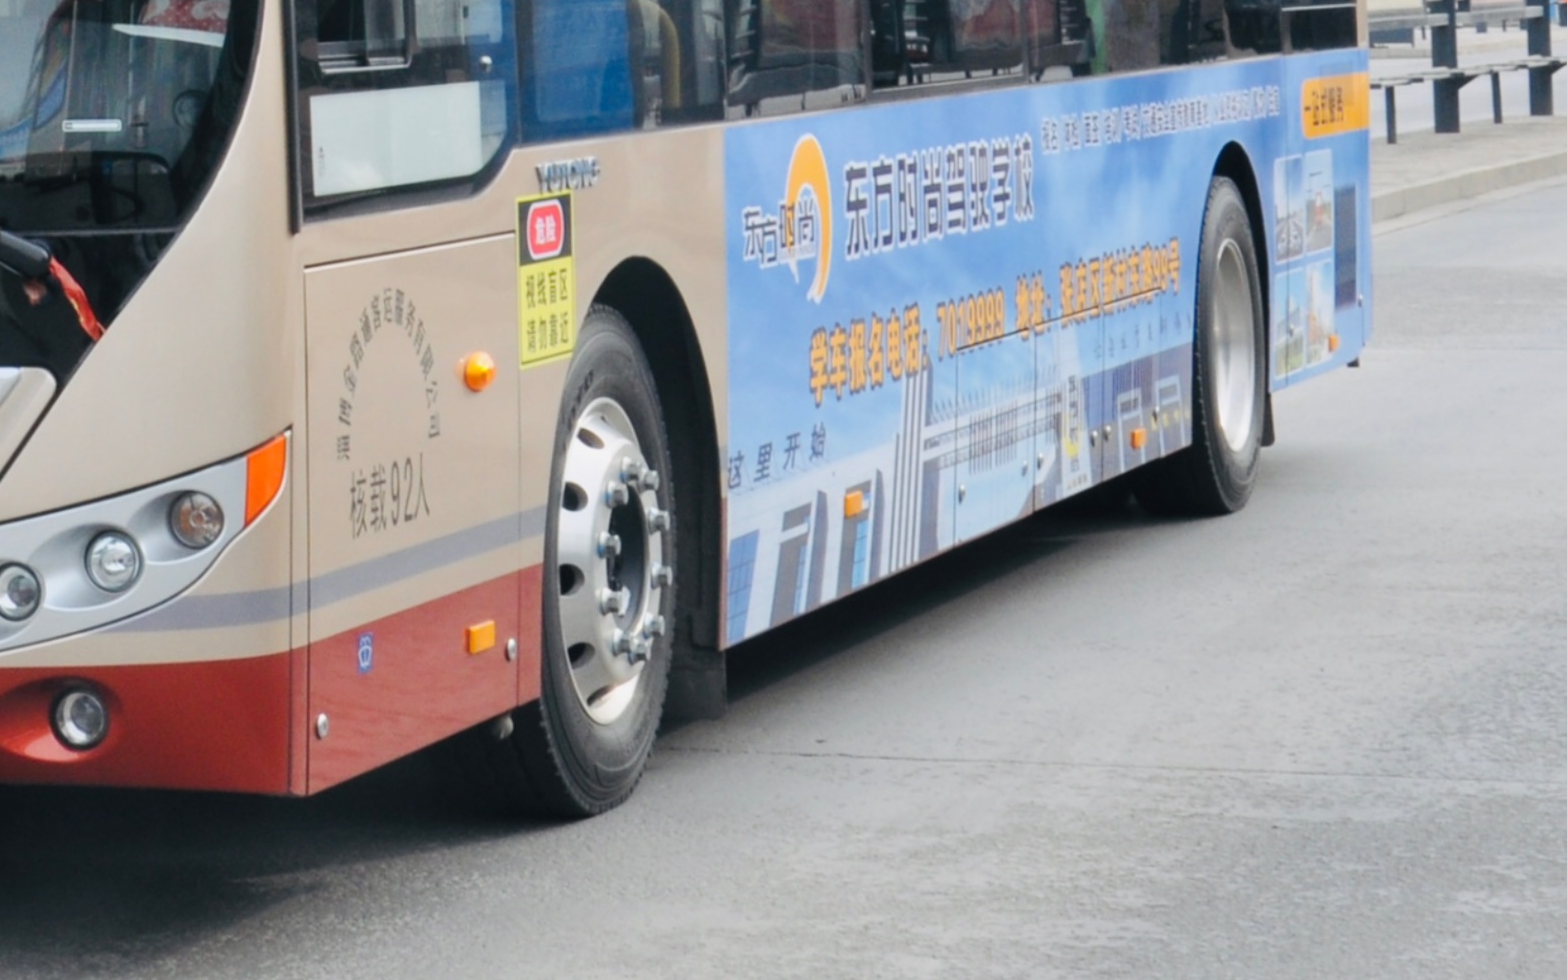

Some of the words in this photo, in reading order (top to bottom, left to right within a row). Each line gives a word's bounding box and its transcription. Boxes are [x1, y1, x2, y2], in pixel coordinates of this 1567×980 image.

[742, 196, 815, 268] 东方时尚
[844, 133, 1033, 261] 东方时尚驾驶学校
[936, 286, 1006, 362] 7019999
[727, 422, 828, 491] 这里开始
[349, 451, 431, 541] 核载92人
